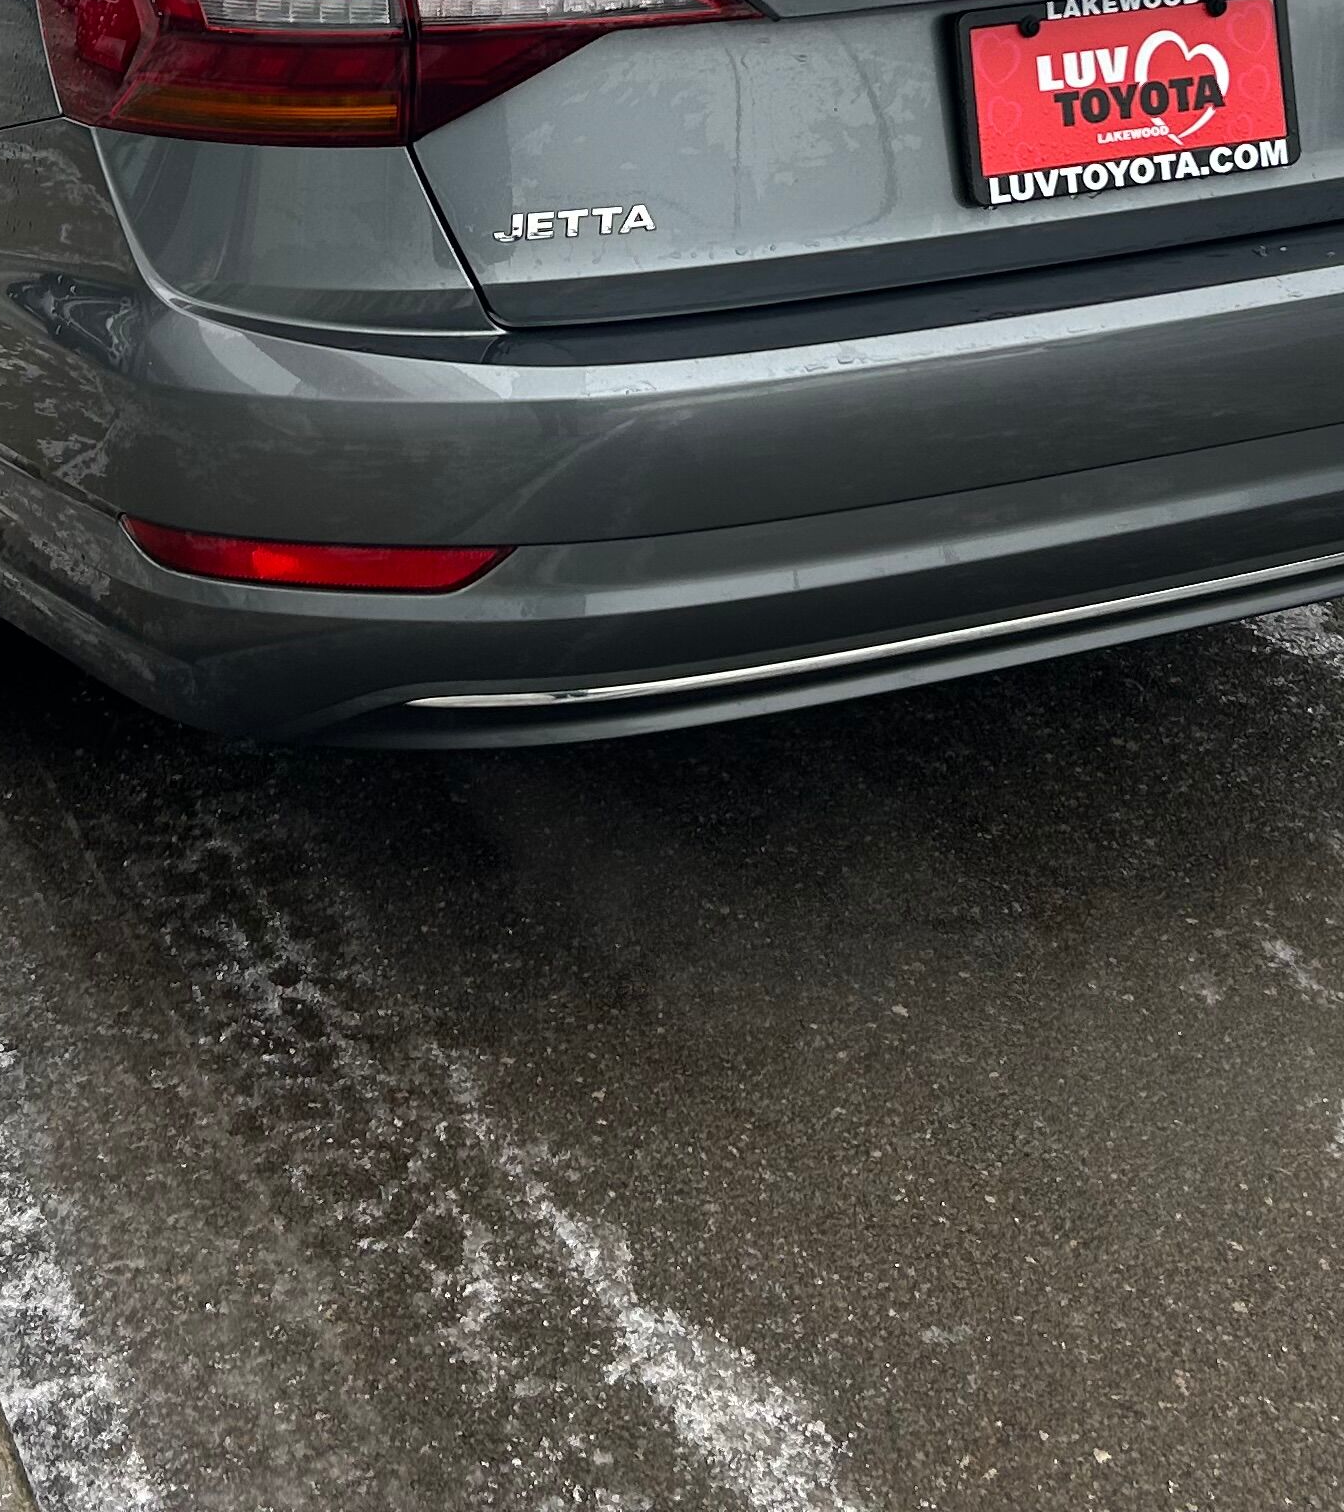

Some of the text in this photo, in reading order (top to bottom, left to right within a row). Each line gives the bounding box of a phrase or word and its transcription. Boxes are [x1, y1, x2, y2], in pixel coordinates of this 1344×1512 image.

[1036, 46, 1129, 92] LUV
[1053, 74, 1226, 128] TOYOTA
[1097, 125, 1170, 145] LAKEWOOD
[989, 140, 1289, 205] LUVTOYOTA.COM
[493, 204, 656, 243] JETTA
